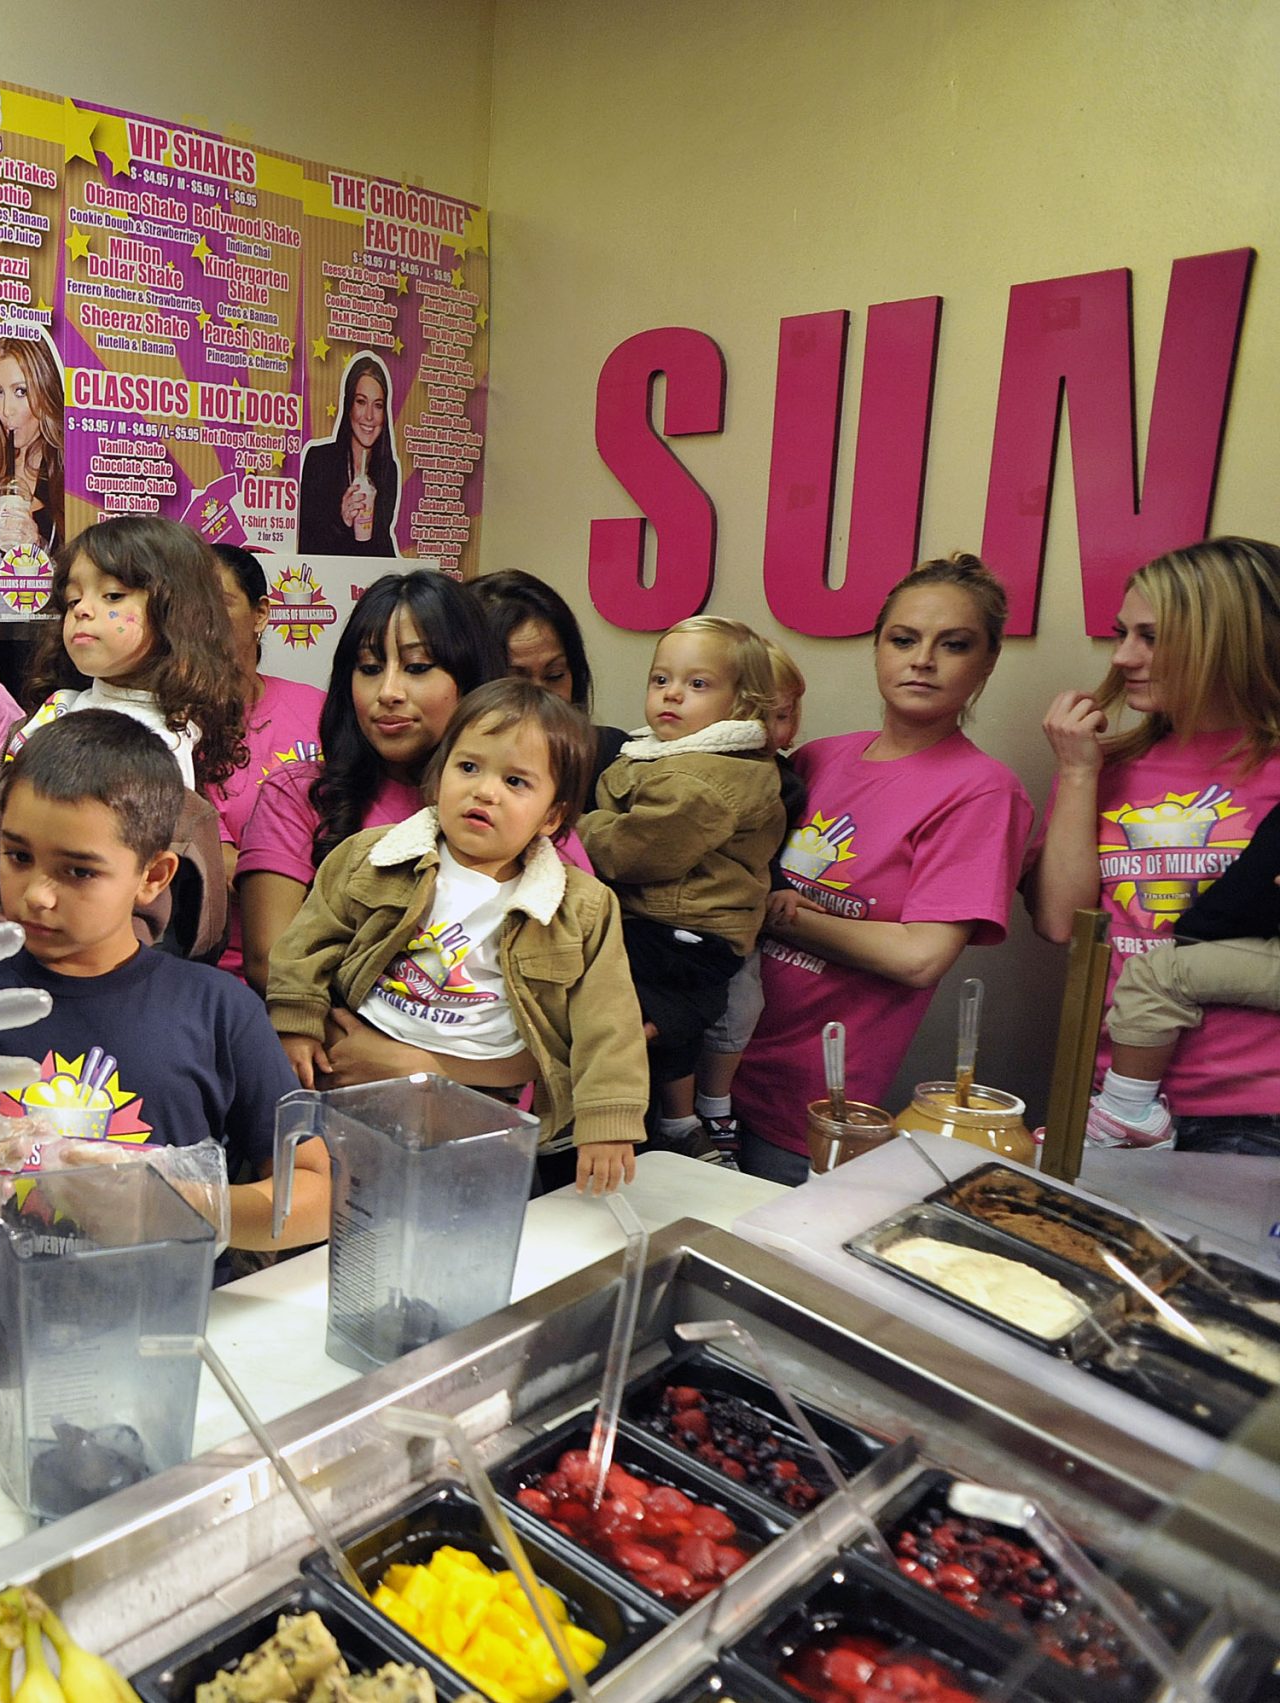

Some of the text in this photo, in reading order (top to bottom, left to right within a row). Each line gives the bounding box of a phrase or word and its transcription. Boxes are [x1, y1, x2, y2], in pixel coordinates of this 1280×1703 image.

[128, 122, 256, 185] VIP SHAKES
[5, 159, 17, 178] it
[17, 162, 56, 188] Takes
[85, 183, 186, 222] Obama Shake
[330, 174, 464, 236] THE CHOCOLATE
[69, 208, 200, 245] Cookie Dough & Strawberries
[193, 205, 301, 247] Bollywood Shake
[365, 218, 441, 264] FACTORY
[109, 237, 162, 266] Million
[89, 255, 183, 290] Dollar Shake
[204, 256, 289, 290] Kindergarten
[67, 280, 202, 312] Ferrero Rocher Strawberries
[81, 305, 190, 338] Sheeraz Shake
[96, 334, 175, 356] Nutella Banana
[74, 371, 189, 415] CLASSICS
[200, 382, 298, 427] HOT DOGS
[91, 458, 173, 477] Chocolate Shake
[243, 478, 297, 511] GIFTS
[241, 515, 295, 531] T-Shirt $15.00
[1099, 855, 1142, 879] LIONS
[1145, 854, 1163, 876] OF
